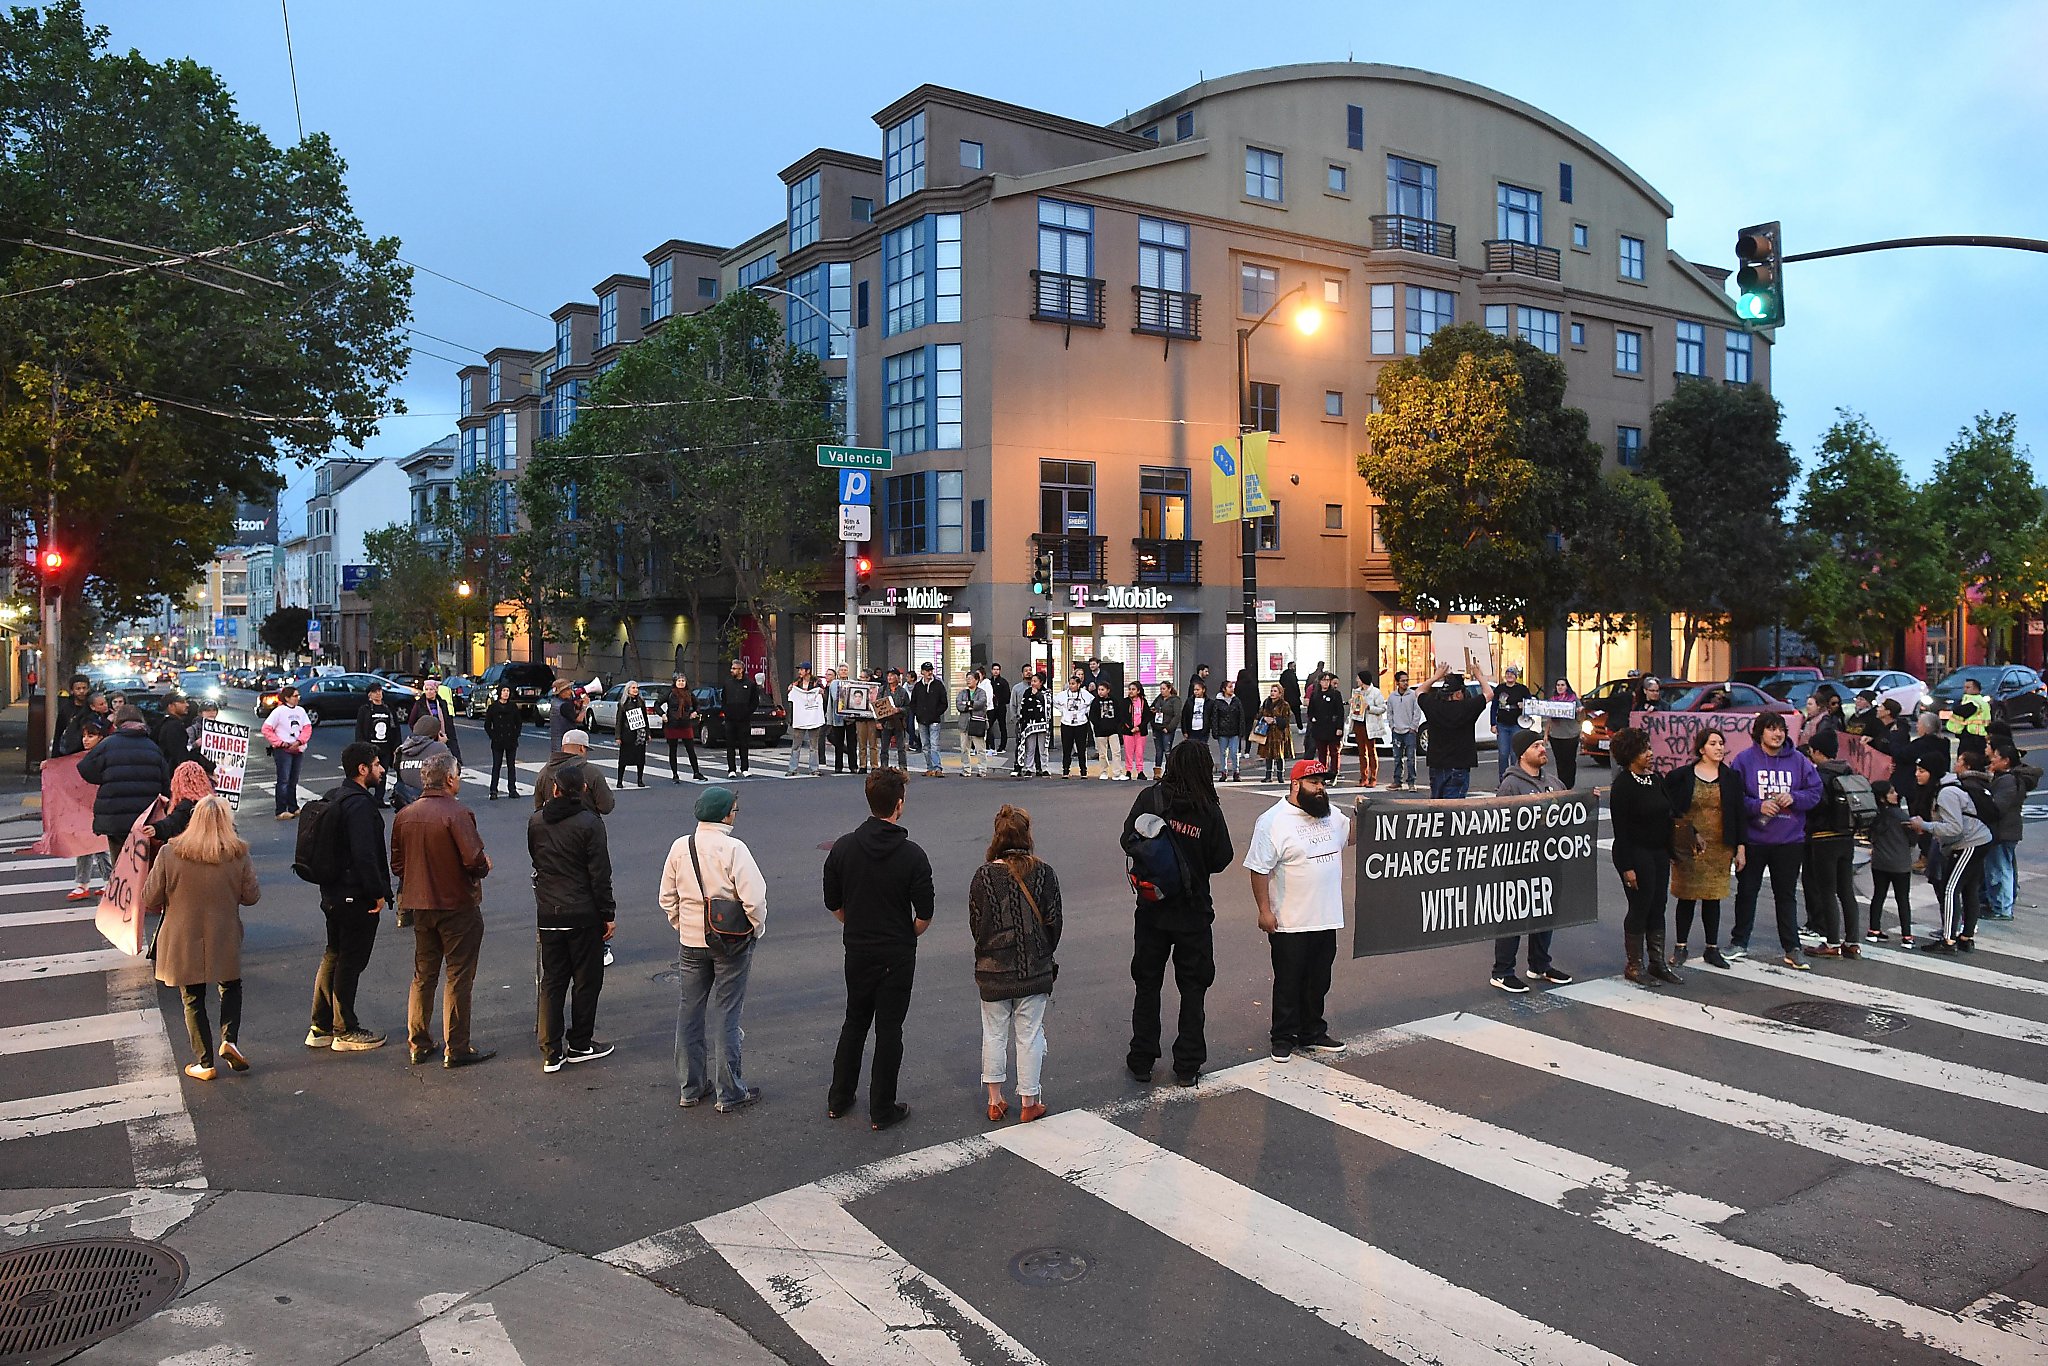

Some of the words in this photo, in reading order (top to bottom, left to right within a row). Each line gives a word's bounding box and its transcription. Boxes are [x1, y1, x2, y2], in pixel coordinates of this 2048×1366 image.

[828, 450, 883, 465] Valencia
[205, 733, 247, 754] CHARGE
[1757, 769, 1792, 786] CALI
[1374, 814, 1399, 841] IN
[1405, 812, 1445, 839] THE
[1450, 808, 1512, 837] NAME
[1516, 805, 1542, 832] OF
[1545, 801, 1588, 828] GOD
[1308, 834, 1332, 844] POLICE
[1365, 847, 1452, 880] CHARGE
[1456, 845, 1489, 871] THE
[1491, 839, 1540, 868] KILLER
[1543, 834, 1592, 862] COPS
[1420, 885, 1469, 933] WITH
[1473, 876, 1554, 926] MURDER
